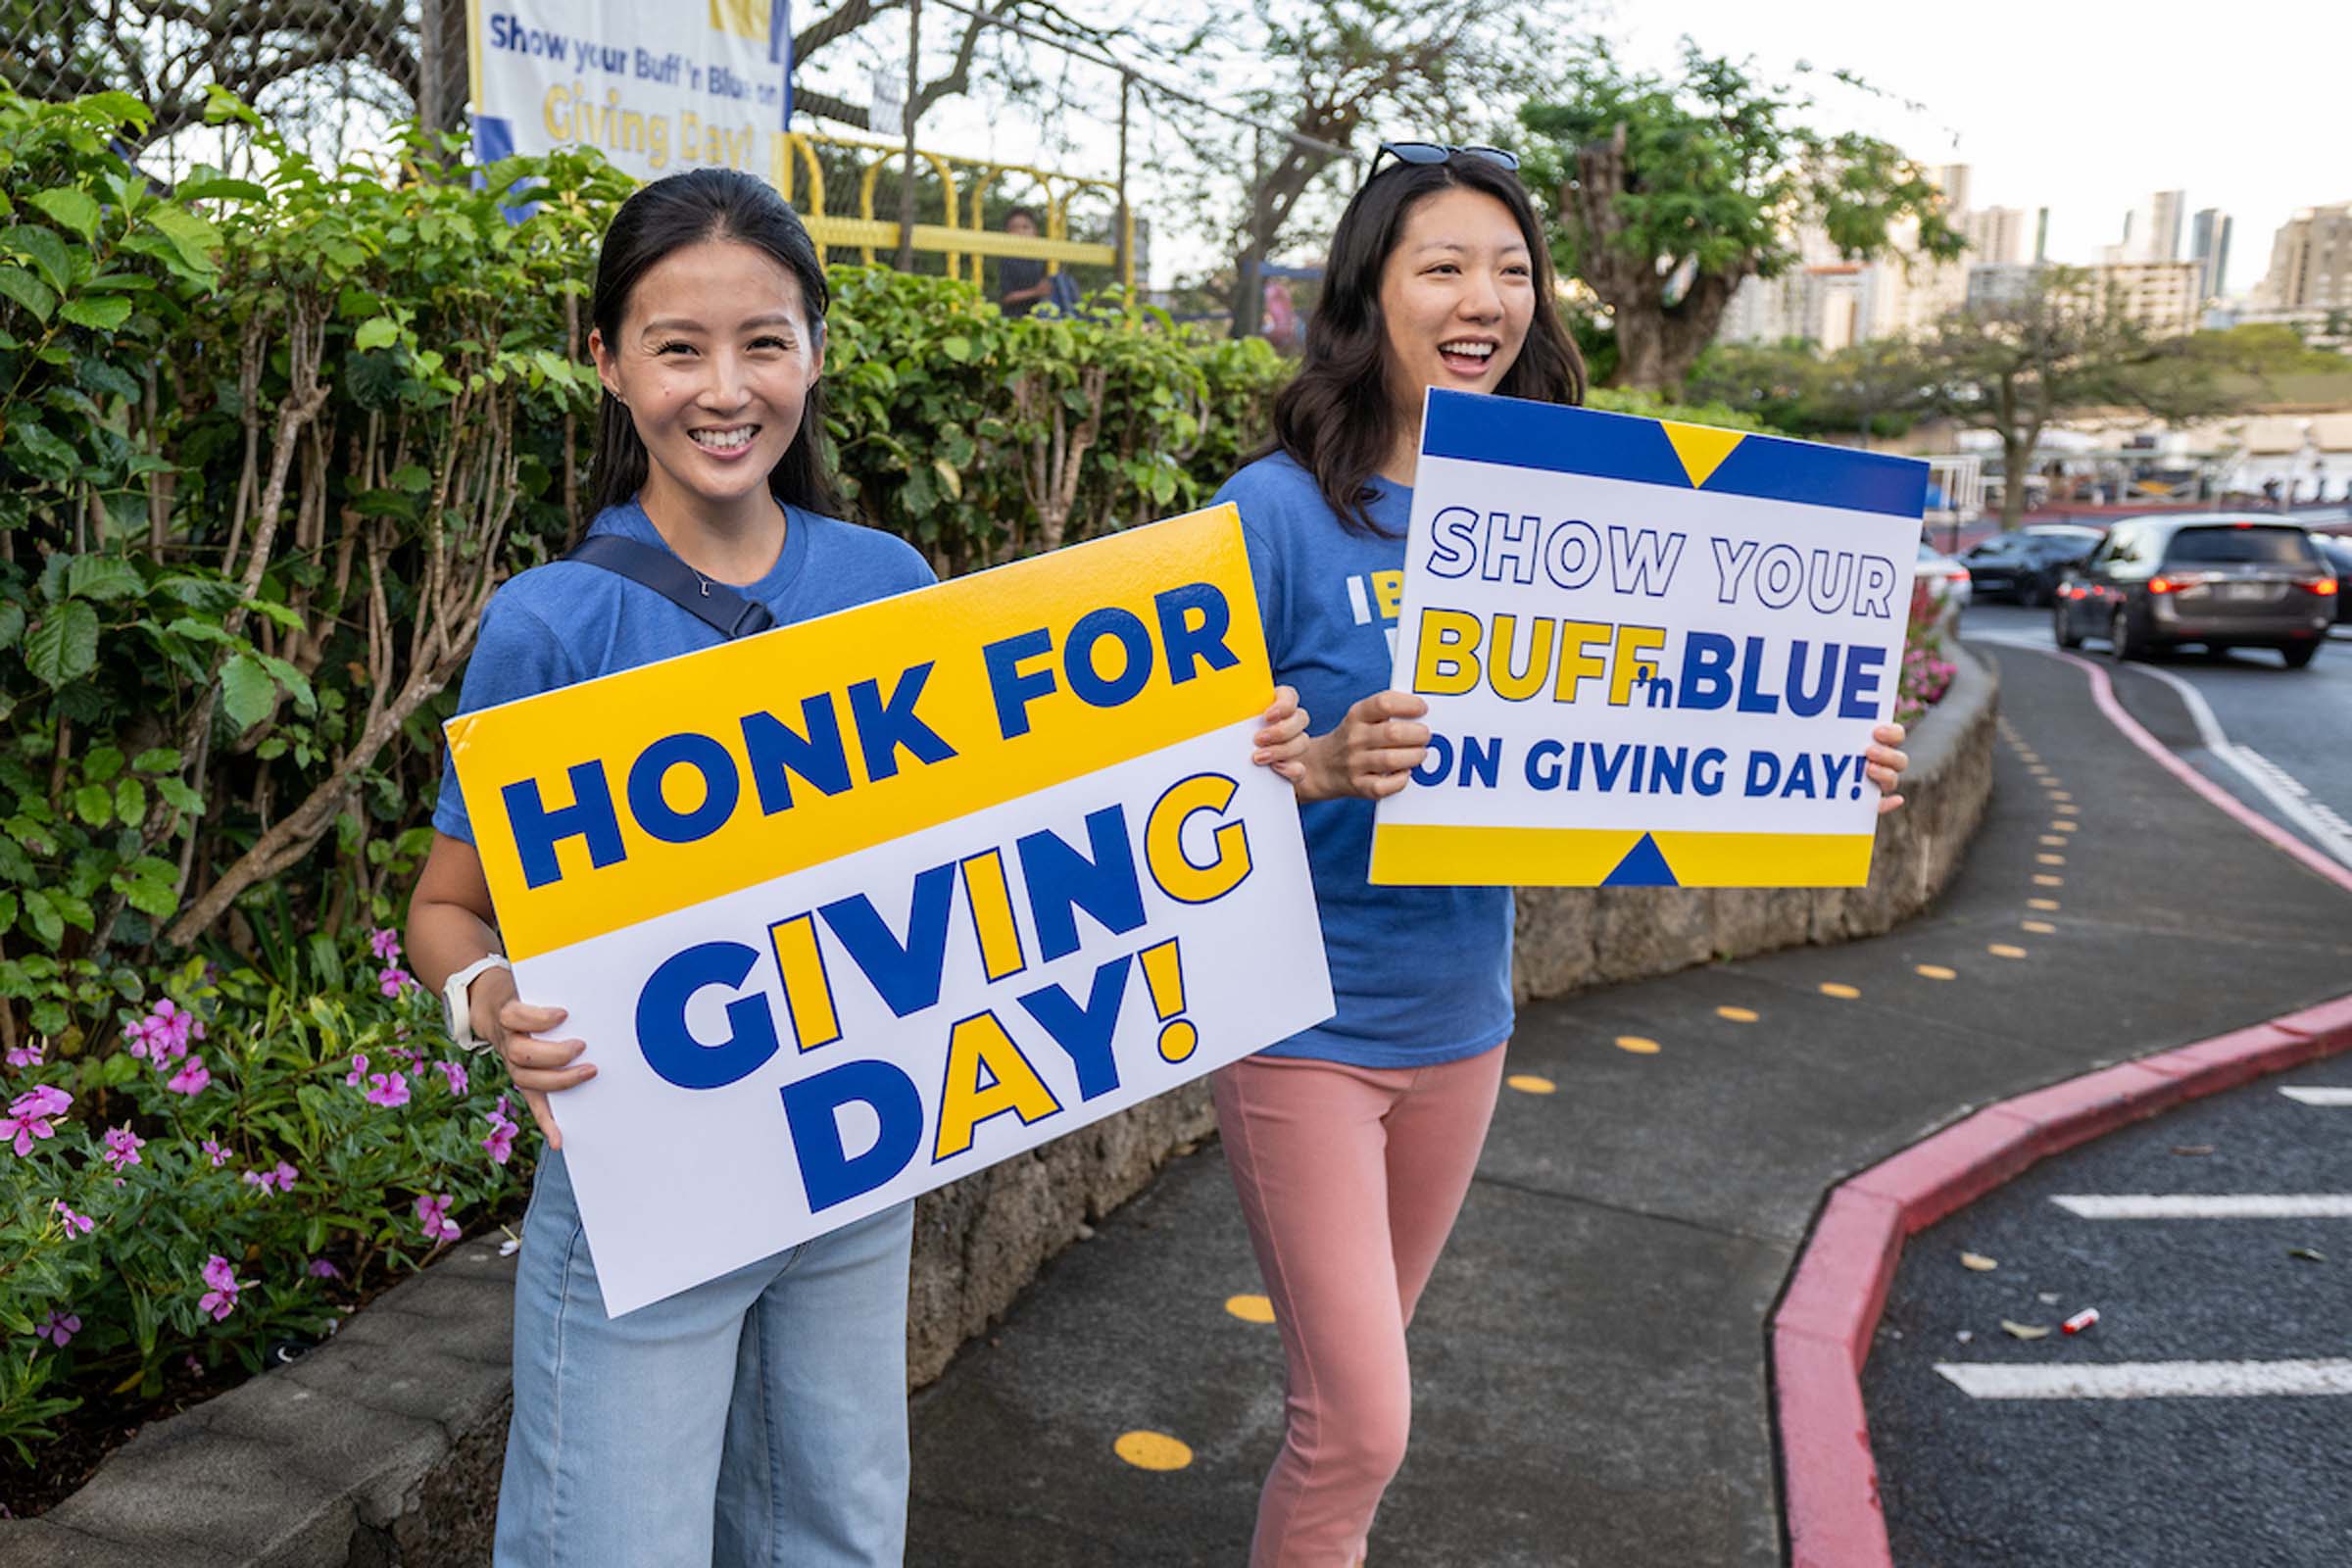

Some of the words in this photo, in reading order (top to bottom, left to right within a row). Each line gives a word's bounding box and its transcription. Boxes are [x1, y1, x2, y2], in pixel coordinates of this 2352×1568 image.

[491, 14, 567, 61] Show
[574, 40, 627, 74] your
[636, 47, 682, 85] Buff
[544, 82, 669, 169] Giving
[680, 110, 754, 171] Day!
[1426, 506, 1686, 597] SHOW
[1712, 537, 1896, 619] YOUR
[1413, 608, 1666, 708] BUFF
[1678, 631, 1886, 720] BLUE
[503, 661, 957, 889] HONK
[983, 582, 1241, 740] FOR
[1409, 732, 1502, 789] ON
[1525, 738, 1728, 797] GIVING
[1743, 751, 1867, 801] DAY!
[635, 771, 1252, 1090] GIVING
[779, 937, 1198, 1214] DAY!
